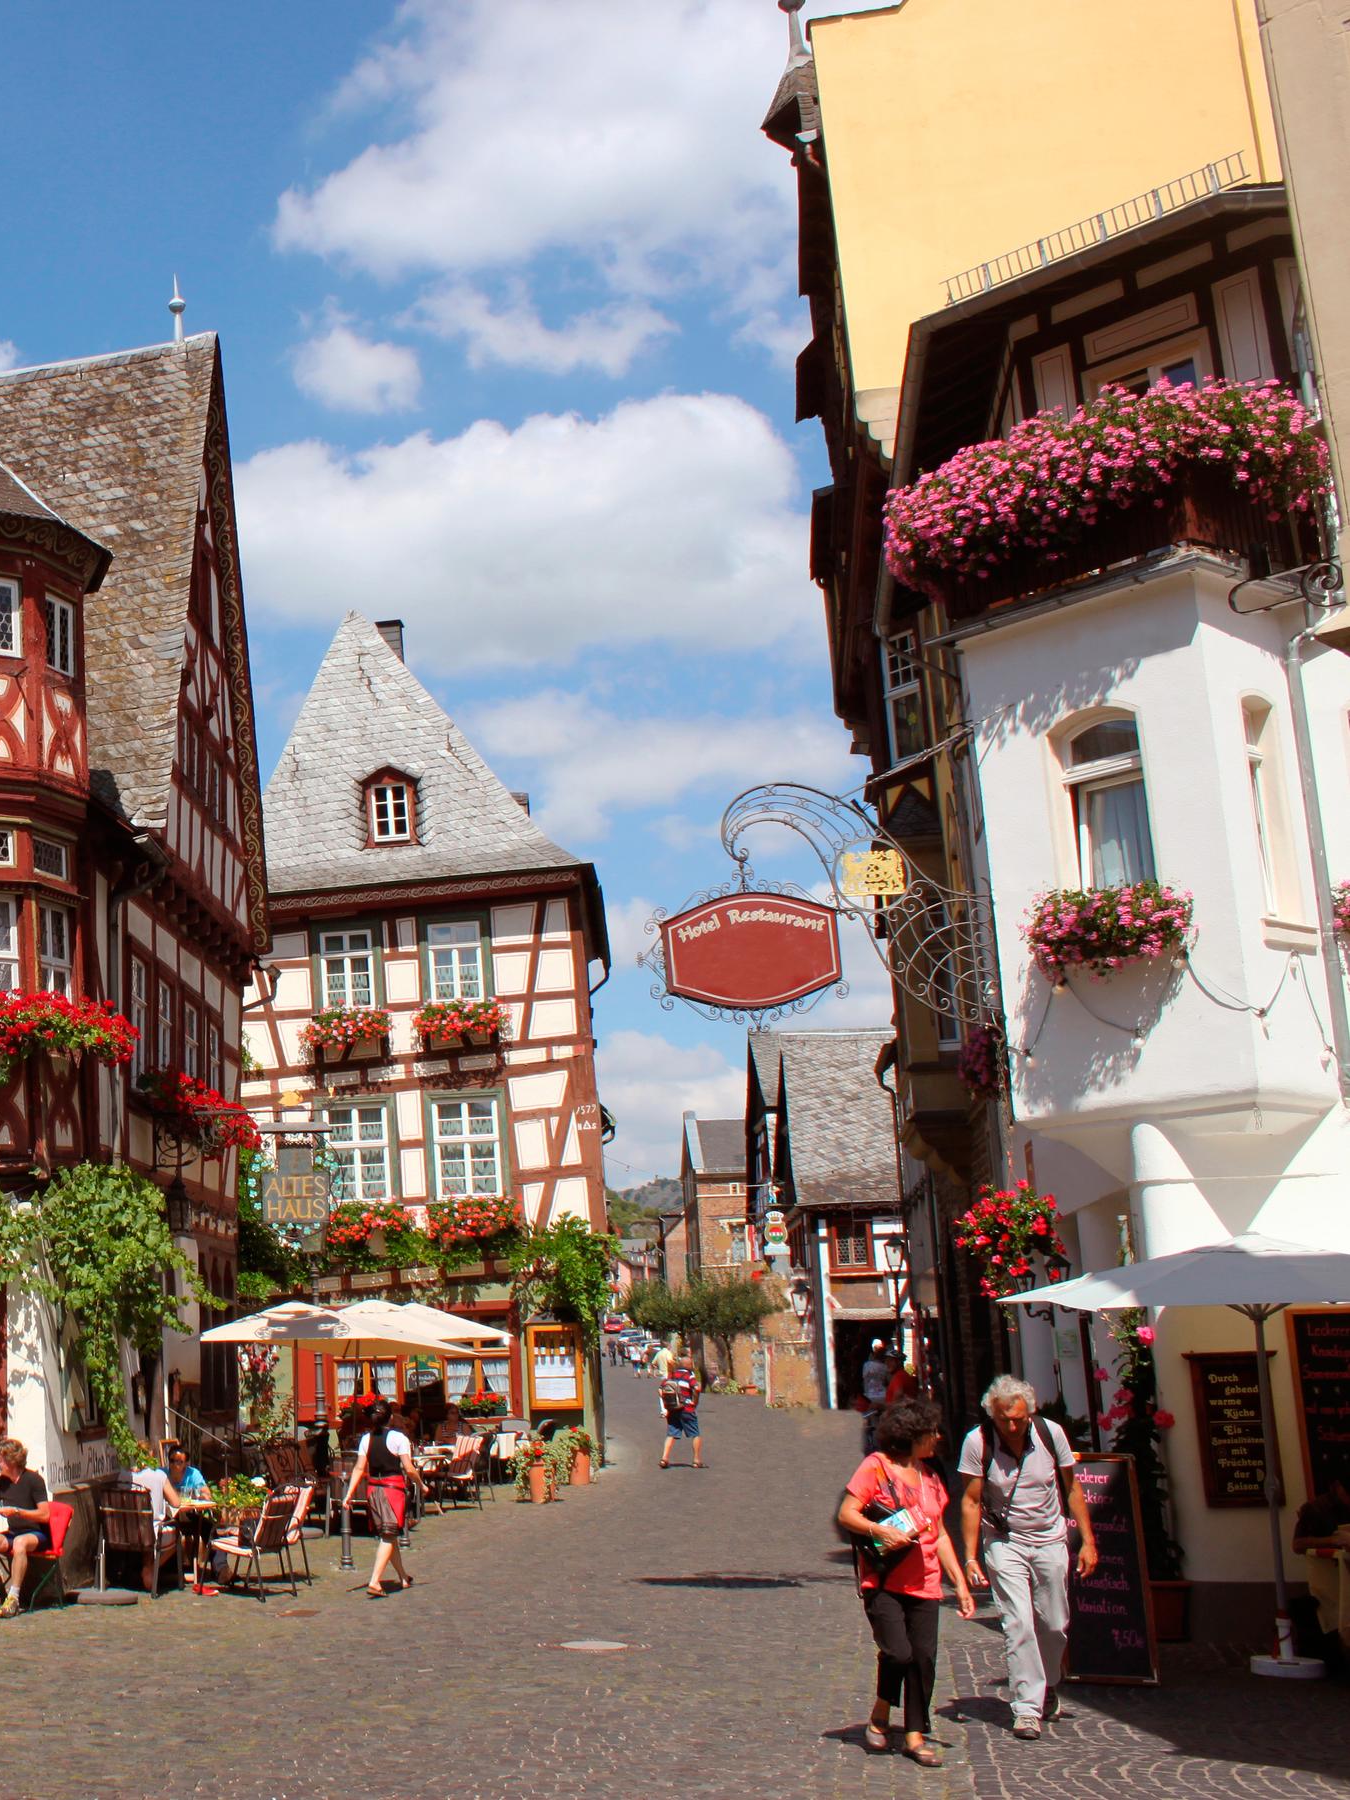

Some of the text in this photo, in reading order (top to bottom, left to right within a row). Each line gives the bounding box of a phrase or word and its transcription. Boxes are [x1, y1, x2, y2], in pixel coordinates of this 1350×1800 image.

[678, 908, 826, 943] Hotel Restaurant
[265, 1175, 326, 1197] ALTES
[266, 1198, 326, 1219] HAUS
[1207, 1373, 1239, 1384] Durch
[1208, 1398, 1242, 1406] warme
[1231, 1446, 1248, 1455] mit
[1074, 1467, 1110, 1484] eckerer
